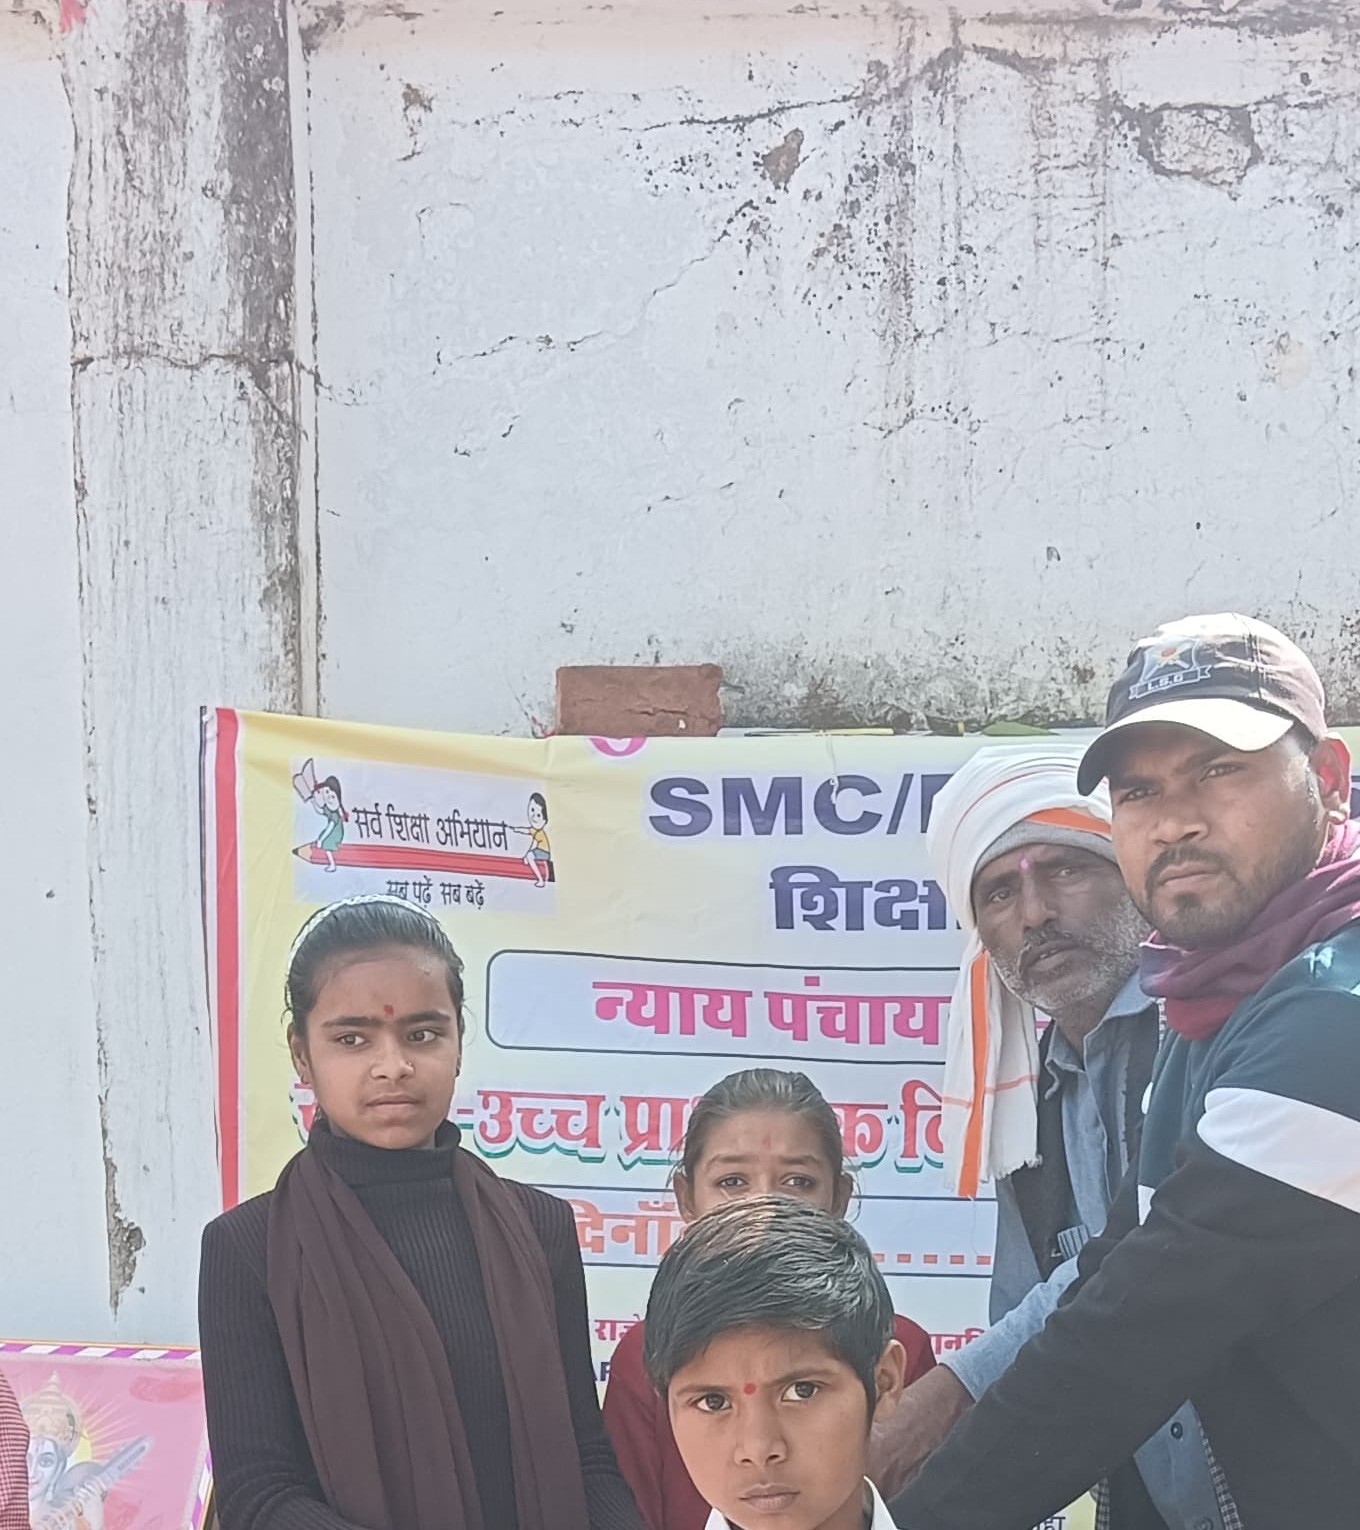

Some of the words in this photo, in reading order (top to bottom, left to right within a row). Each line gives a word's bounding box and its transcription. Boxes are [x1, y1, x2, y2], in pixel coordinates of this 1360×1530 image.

[352, 803, 382, 839] सर्व
[385, 803, 430, 844] शिक्षा
[436, 808, 509, 850] अभियान
[440, 881, 461, 905] सब
[592, 981, 753, 1038] न्याय
[764, 976, 952, 1046] पंचाय
